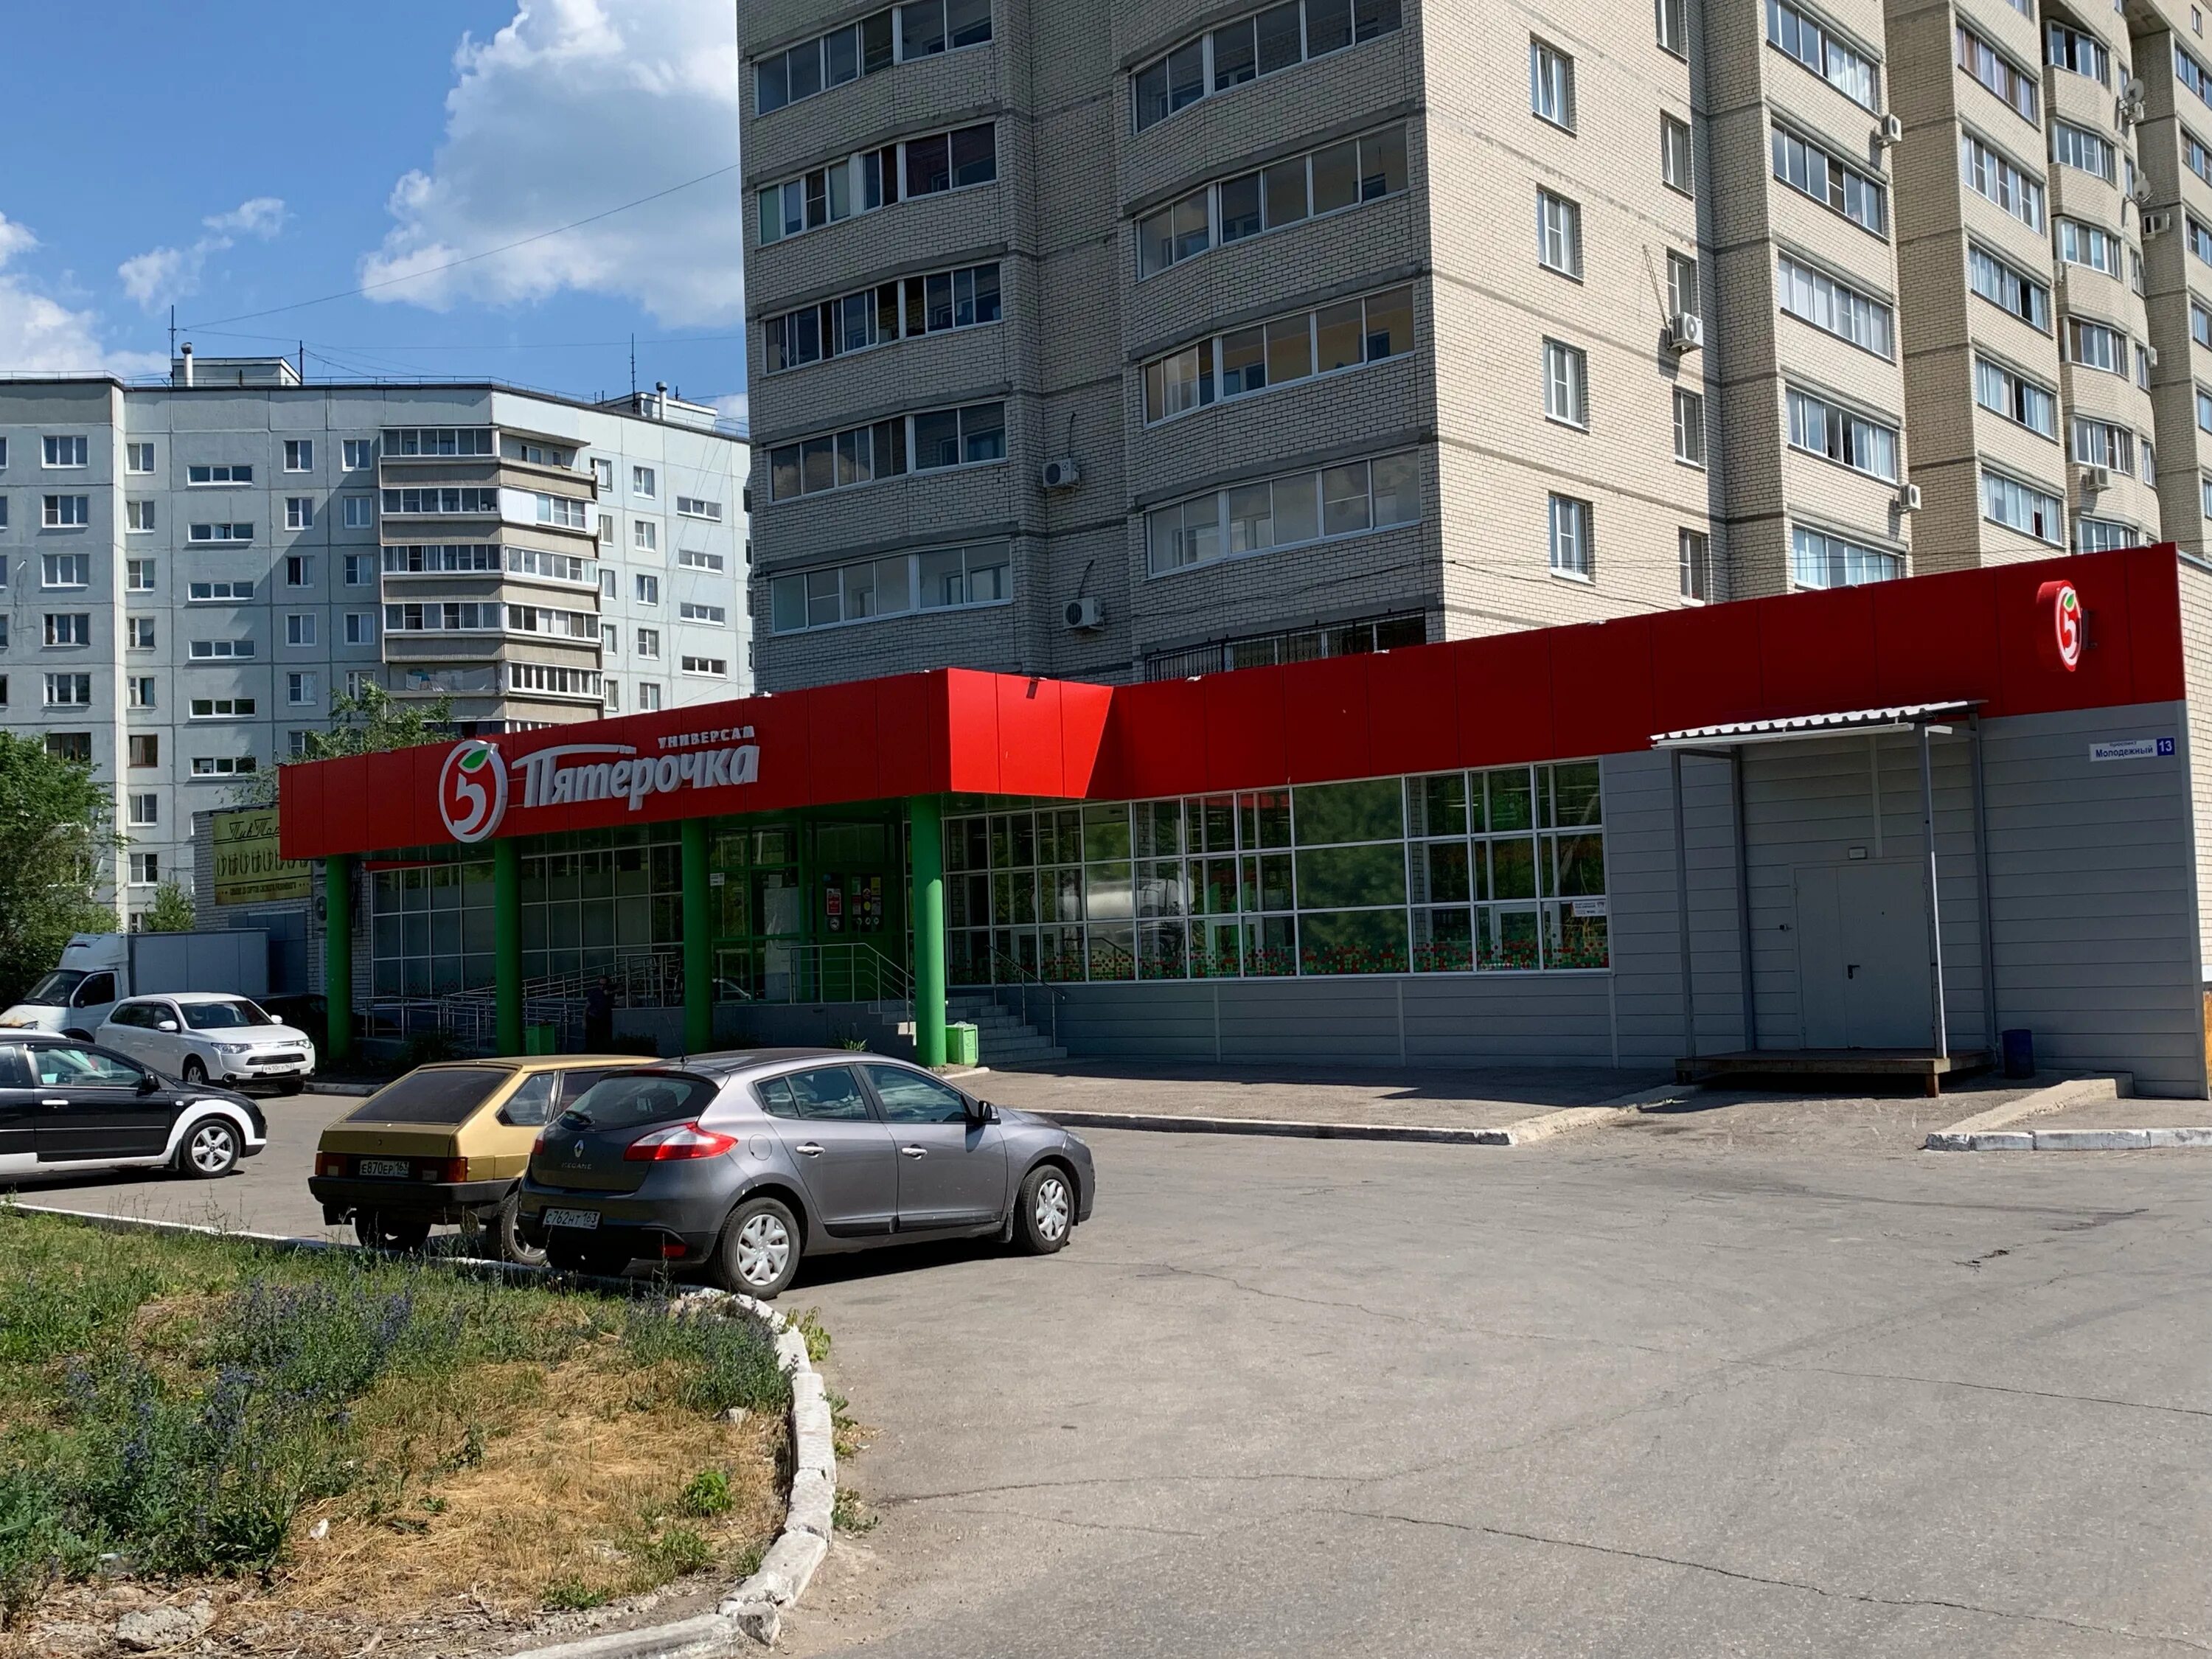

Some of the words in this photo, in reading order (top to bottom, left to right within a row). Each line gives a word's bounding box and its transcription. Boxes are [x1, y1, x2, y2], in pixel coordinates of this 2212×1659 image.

[658, 726, 755, 749] УНИВЕРСАМ
[2096, 745, 2154, 758] Молодежный
[2158, 740, 2172, 752] 13
[512, 743, 760, 811] Пятерочка
[546, 1211, 581, 1225] С762НТ
[583, 1211, 598, 1223] 163
